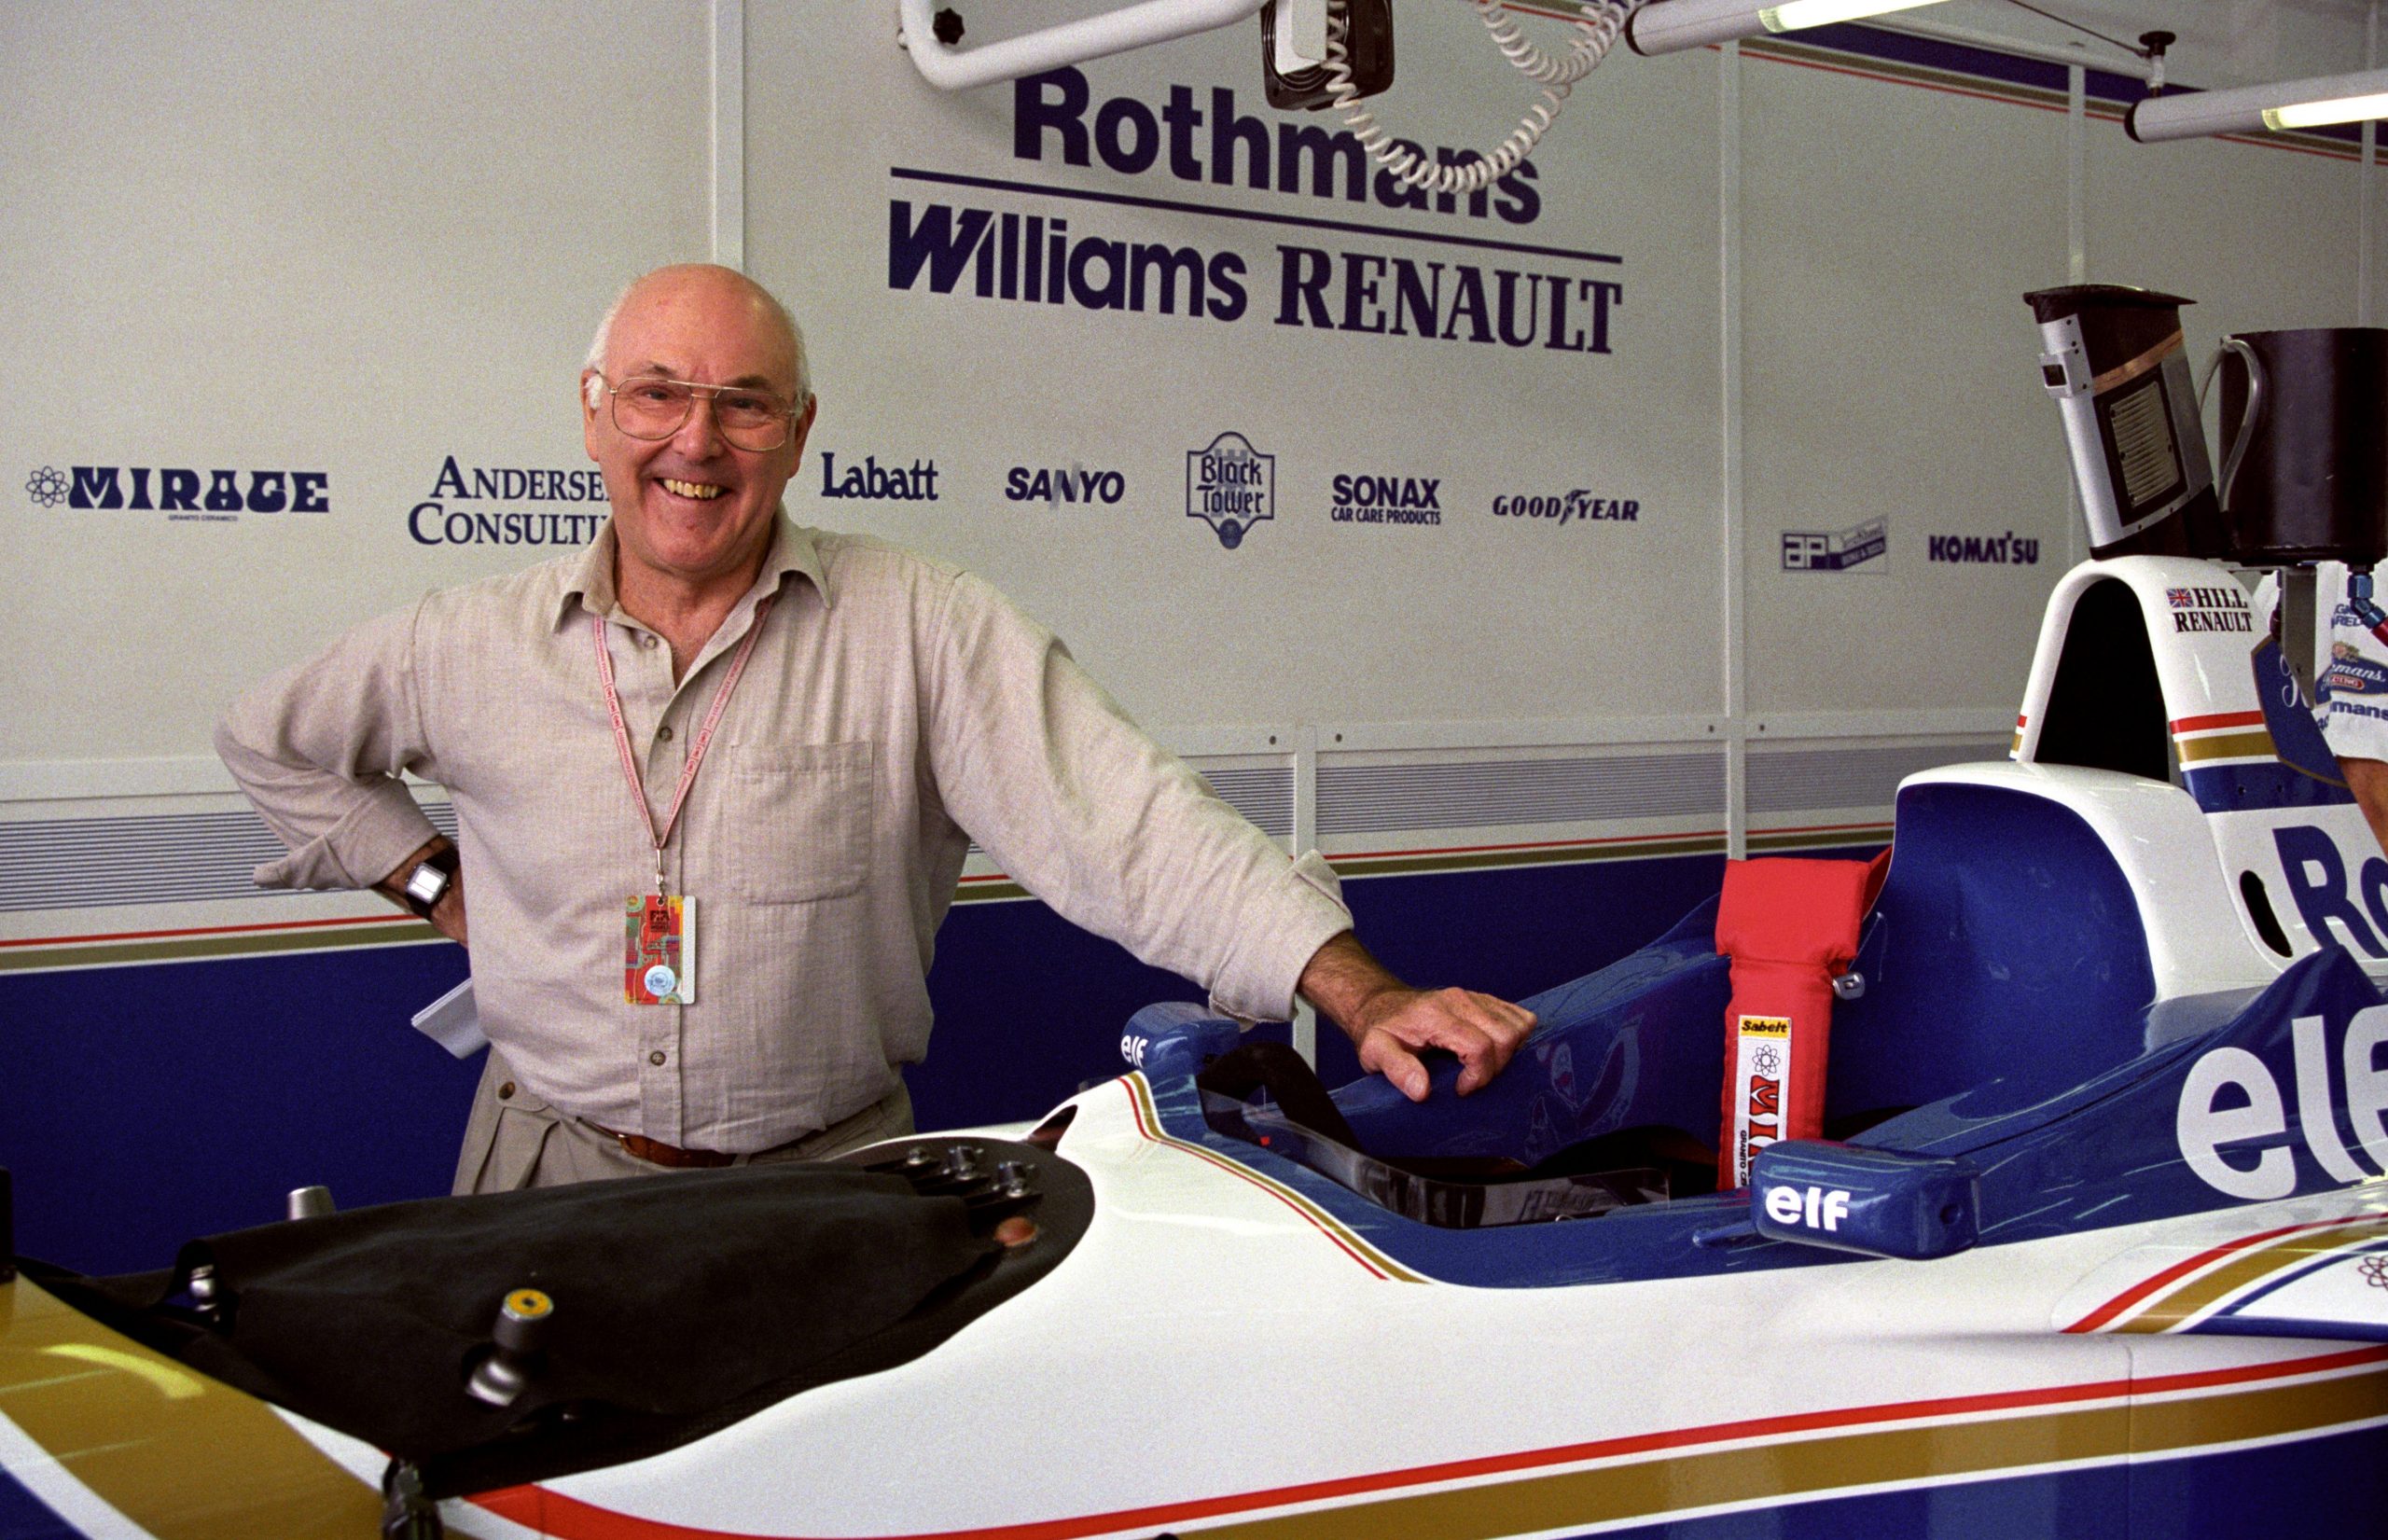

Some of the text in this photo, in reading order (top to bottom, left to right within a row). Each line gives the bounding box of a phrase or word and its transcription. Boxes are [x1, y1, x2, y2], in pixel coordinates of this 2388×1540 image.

[1013, 64, 1542, 225] Rothmans
[889, 200, 1623, 354] Williams RENAULT
[429, 454, 611, 502] ANDERSE
[821, 451, 938, 501] Labatt
[1005, 463, 1126, 508] SANYO
[1201, 454, 1262, 485] Black
[68, 466, 330, 513] MIRAGE
[1196, 485, 1264, 514] Tower
[1332, 474, 1440, 509] SONAX
[408, 502, 608, 545] CONSULTI
[1331, 506, 1441, 525] CAR CARE PRODUCTS
[1928, 531, 2039, 564] KOMATSU
[2192, 588, 2248, 608] HILL
[2173, 611, 2253, 632] RENAULT
[1742, 1020, 1788, 1034] Sabelt
[1121, 1035, 1148, 1069] elf
[1766, 1186, 1851, 1231] elf
